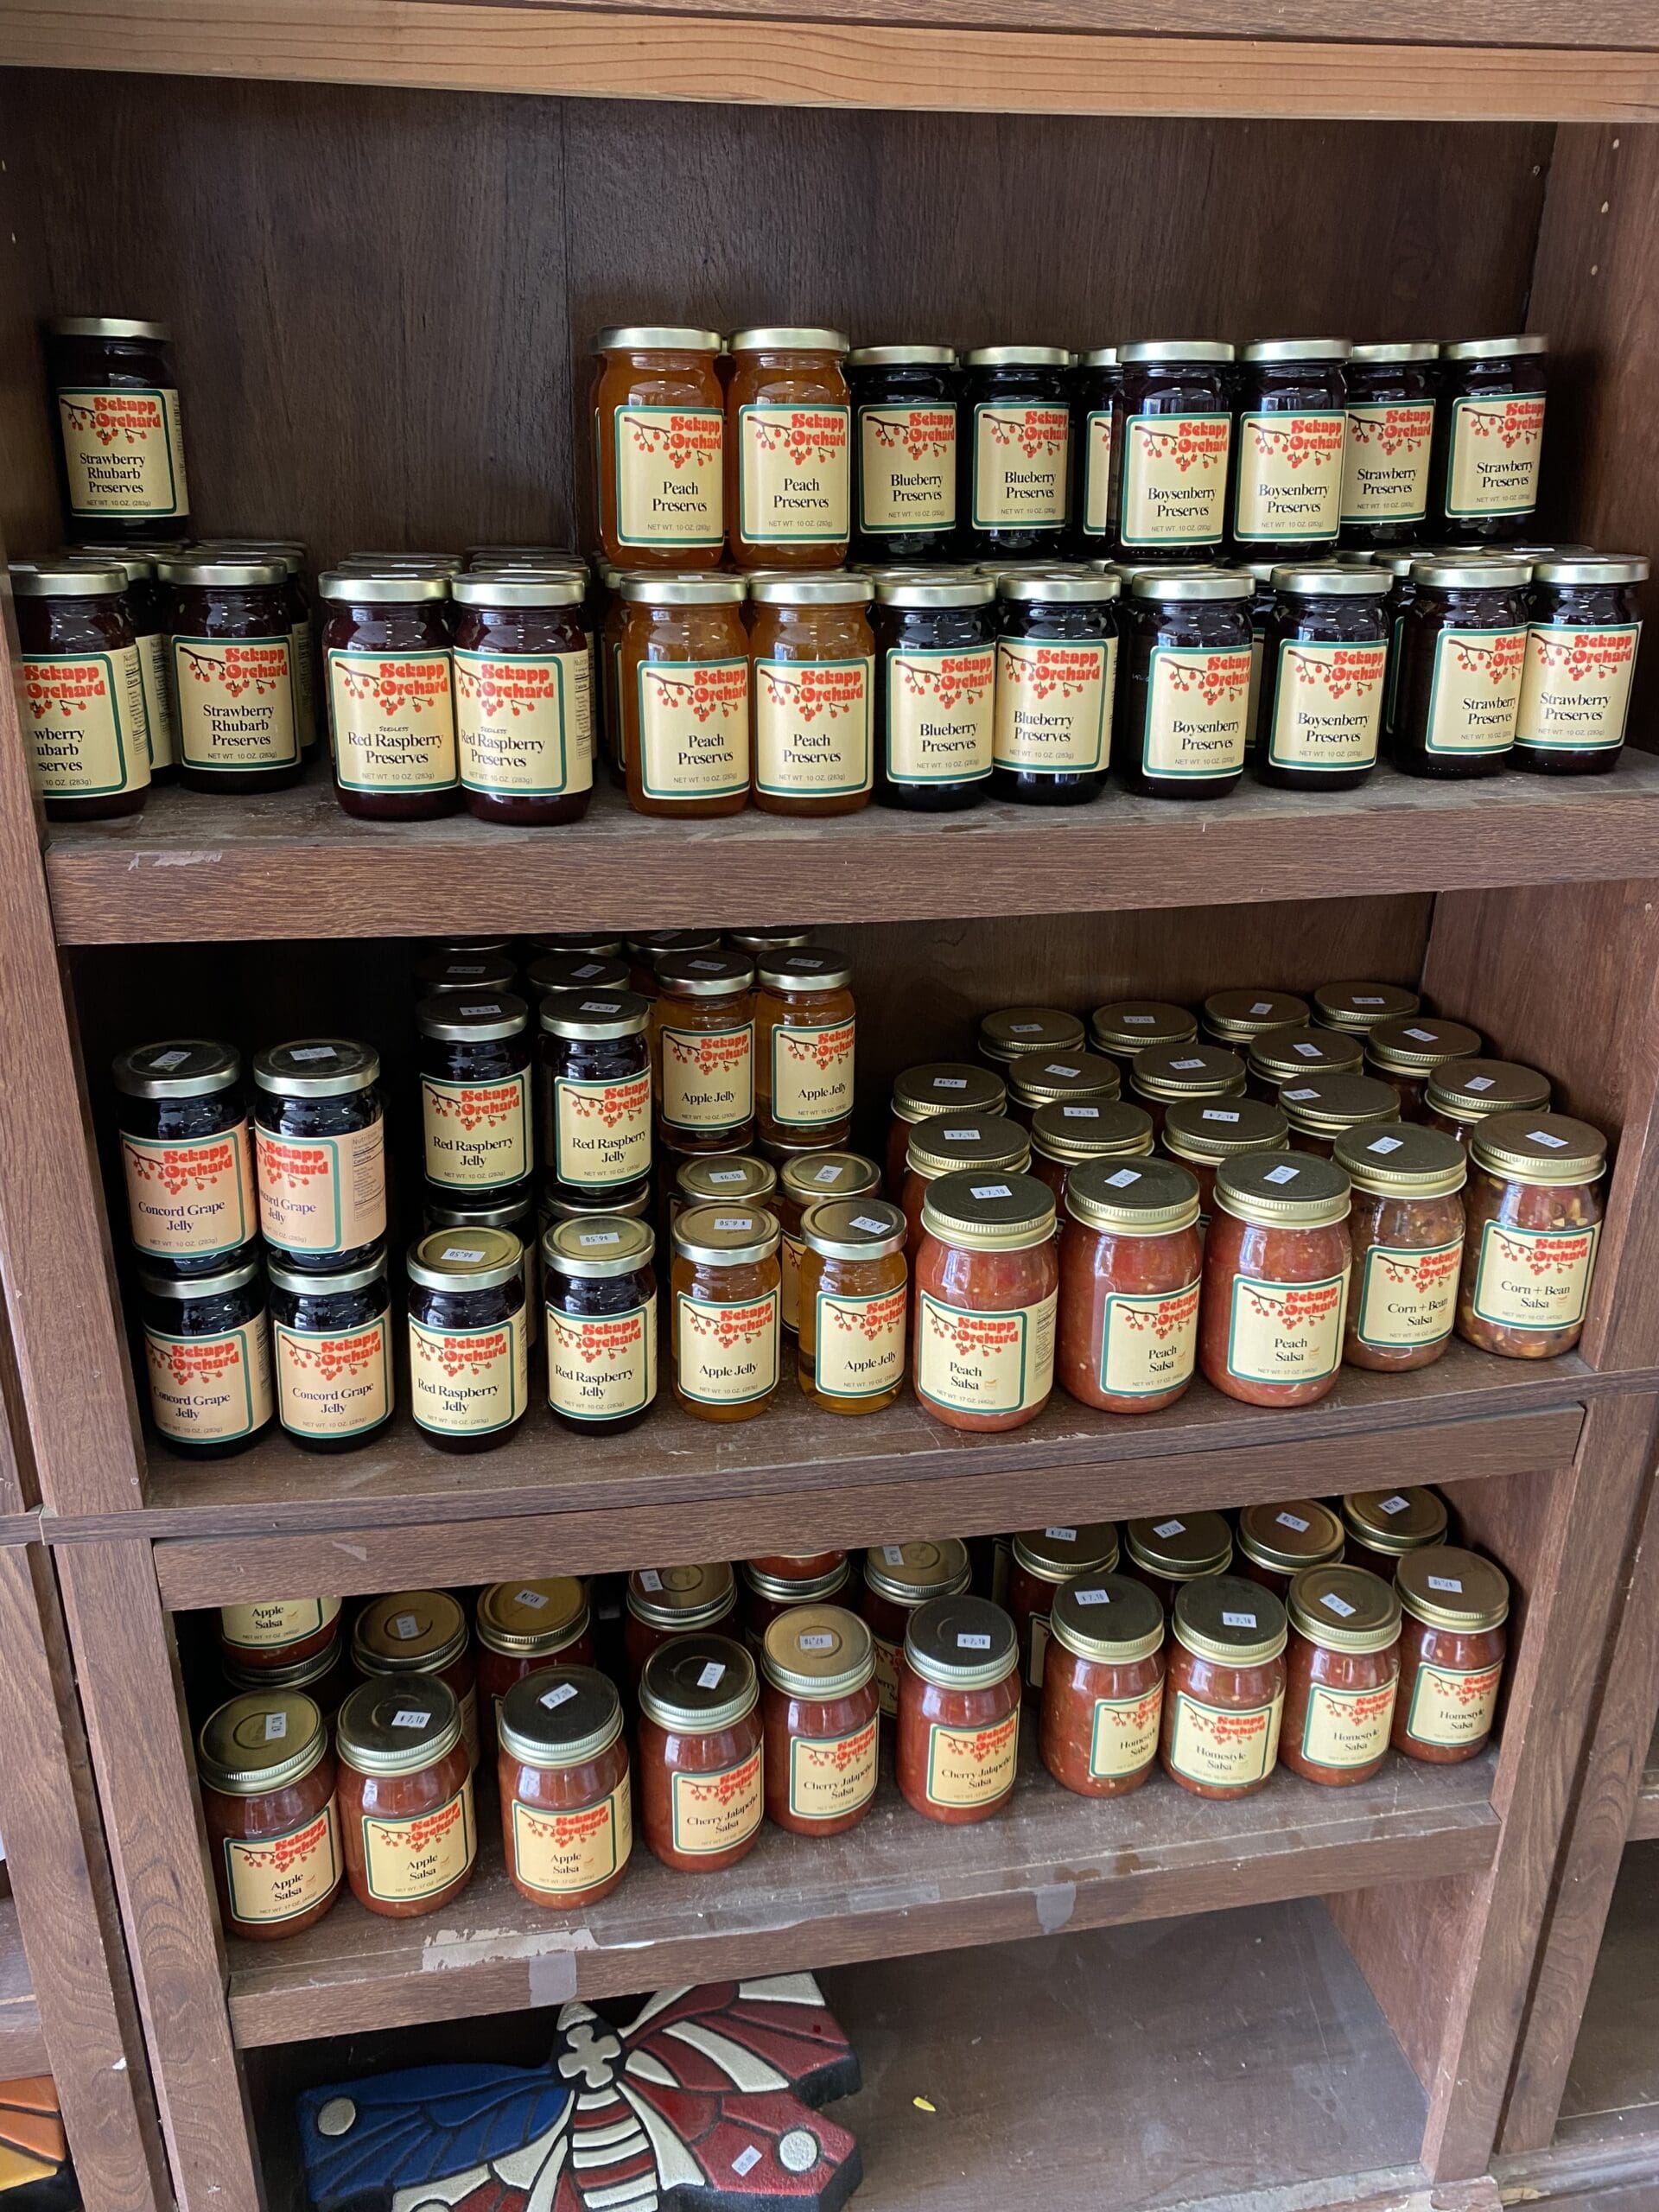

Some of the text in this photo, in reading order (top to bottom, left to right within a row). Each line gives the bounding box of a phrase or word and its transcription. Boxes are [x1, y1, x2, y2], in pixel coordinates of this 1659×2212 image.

[96, 413, 161, 428] Orchard
[791, 430, 846, 447] Orchard
[79, 453, 145, 467] Strawberry
[87, 467, 140, 479] Rhubarb
[1357, 468, 1417, 480] Strawberry
[1477, 461, 1534, 474] Strawberry
[784, 478, 819, 491] Peach
[891, 474, 943, 487] Blueberry
[1005, 472, 1056, 485] Blueberry
[1482, 476, 1529, 487] Preserves
[89, 481, 143, 493] Preserves
[663, 481, 698, 494] Peach
[1006, 486, 1055, 499] Preserves
[1148, 487, 1217, 501] Boysenberry
[1259, 484, 1330, 499] Boysenberry
[1363, 484, 1412, 494] Preserves
[774, 495, 829, 508] Preserves
[893, 490, 942, 502] Preserves
[652, 498, 707, 512] Preserves
[1157, 504, 1209, 517] Preserves
[1268, 501, 1321, 513] Preserves
[1572, 649, 1631, 664] Orchard
[226, 662, 288, 678] Orchard
[1036, 665, 1100, 680] Orchard
[380, 677, 448, 696] Orchard
[800, 685, 863, 702] Orchard
[1540, 692, 1611, 708] Strawberry
[203, 704, 275, 718] Strawberry
[1545, 708, 1603, 721] Preserves
[212, 719, 269, 731] Rhubarb
[1014, 710, 1074, 728] Blueberry
[1299, 713, 1370, 728] Boysenberry
[1468, 712, 1512, 725] Preserves
[34, 728, 85, 742] wberry
[920, 723, 978, 736] Blueberry
[1014, 727, 1071, 742] Preserves
[1173, 721, 1240, 736] Boysenberry
[213, 734, 271, 746] Preserves
[348, 733, 443, 748] Red Raspberry
[461, 729, 545, 753] Red Raspberry
[689, 734, 724, 747] Peach
[793, 734, 830, 747] Peach
[1306, 729, 1361, 743] Preserves
[37, 743, 79, 756] ubarb
[922, 741, 976, 752] Preserves
[1182, 738, 1233, 750] Preserves
[366, 750, 429, 764] Preserves
[471, 749, 527, 767] Preserves
[678, 752, 734, 765] Preserves
[784, 750, 841, 763] Preserves
[682, 1091, 736, 1105] Apple Jelly
[798, 1083, 846, 1100] Apple Jelly
[434, 1136, 514, 1154] Red Raspberry
[572, 1129, 646, 1149] Red Raspberry
[460, 1156, 487, 1167] Jelly
[601, 1151, 626, 1164] Jelly
[165, 1155, 232, 1179] Orchard
[138, 1200, 225, 1217] Concord Grape
[281, 1199, 316, 1213] Grape
[268, 1210, 286, 1224] Jelly
[167, 1220, 194, 1233] Jelly
[1534, 1249, 1587, 1262] Orchard
[1501, 1281, 1531, 1294] Corn
[1544, 1285, 1571, 1294] Bean
[1388, 1304, 1416, 1313] Corn
[1428, 1298, 1448, 1311] Bean
[1521, 1298, 1549, 1308] Salsa
[1408, 1315, 1433, 1327] Salsa
[957, 1330, 1019, 1344] Orchard
[1274, 1338, 1307, 1351] Peach
[1148, 1345, 1177, 1359] Peach
[1274, 1351, 1304, 1362] Salsa
[844, 1352, 897, 1372] Apple Jelly
[950, 1361, 982, 1377] Peach
[1149, 1360, 1174, 1372] Salsa
[556, 1365, 634, 1385] Red Raspberry
[700, 1363, 758, 1378] Apple Jelly
[418, 1378, 499, 1398] Red Raspberry
[951, 1377, 979, 1390] Salsa
[154, 1387, 231, 1406] Concord Grape
[293, 1383, 374, 1401] Concord Grape
[580, 1386, 606, 1399] Jelly
[176, 1408, 200, 1421] Jelly
[321, 1403, 347, 1414] Jelly
[442, 1401, 469, 1414] Jelly
[252, 1606, 284, 1619] Apple
[255, 1618, 283, 1630] Salsa
[1197, 1745, 1246, 1762] Homestyle
[1207, 1759, 1232, 1771] Salsa
[942, 1768, 977, 1782] Cherry
[804, 1777, 839, 1791] Cherry
[969, 1778, 992, 1789] Salsa
[832, 1789, 855, 1799] Salsa
[687, 1811, 722, 1827] Cherry
[715, 1821, 740, 1834] Salsa
[406, 1854, 438, 1871] Apple
[550, 1853, 582, 1867] Apple
[409, 1867, 437, 1881] Salsa
[553, 1865, 580, 1875] Salsa
[270, 1873, 304, 1891] Apple
[274, 1886, 302, 1903] Salsa
